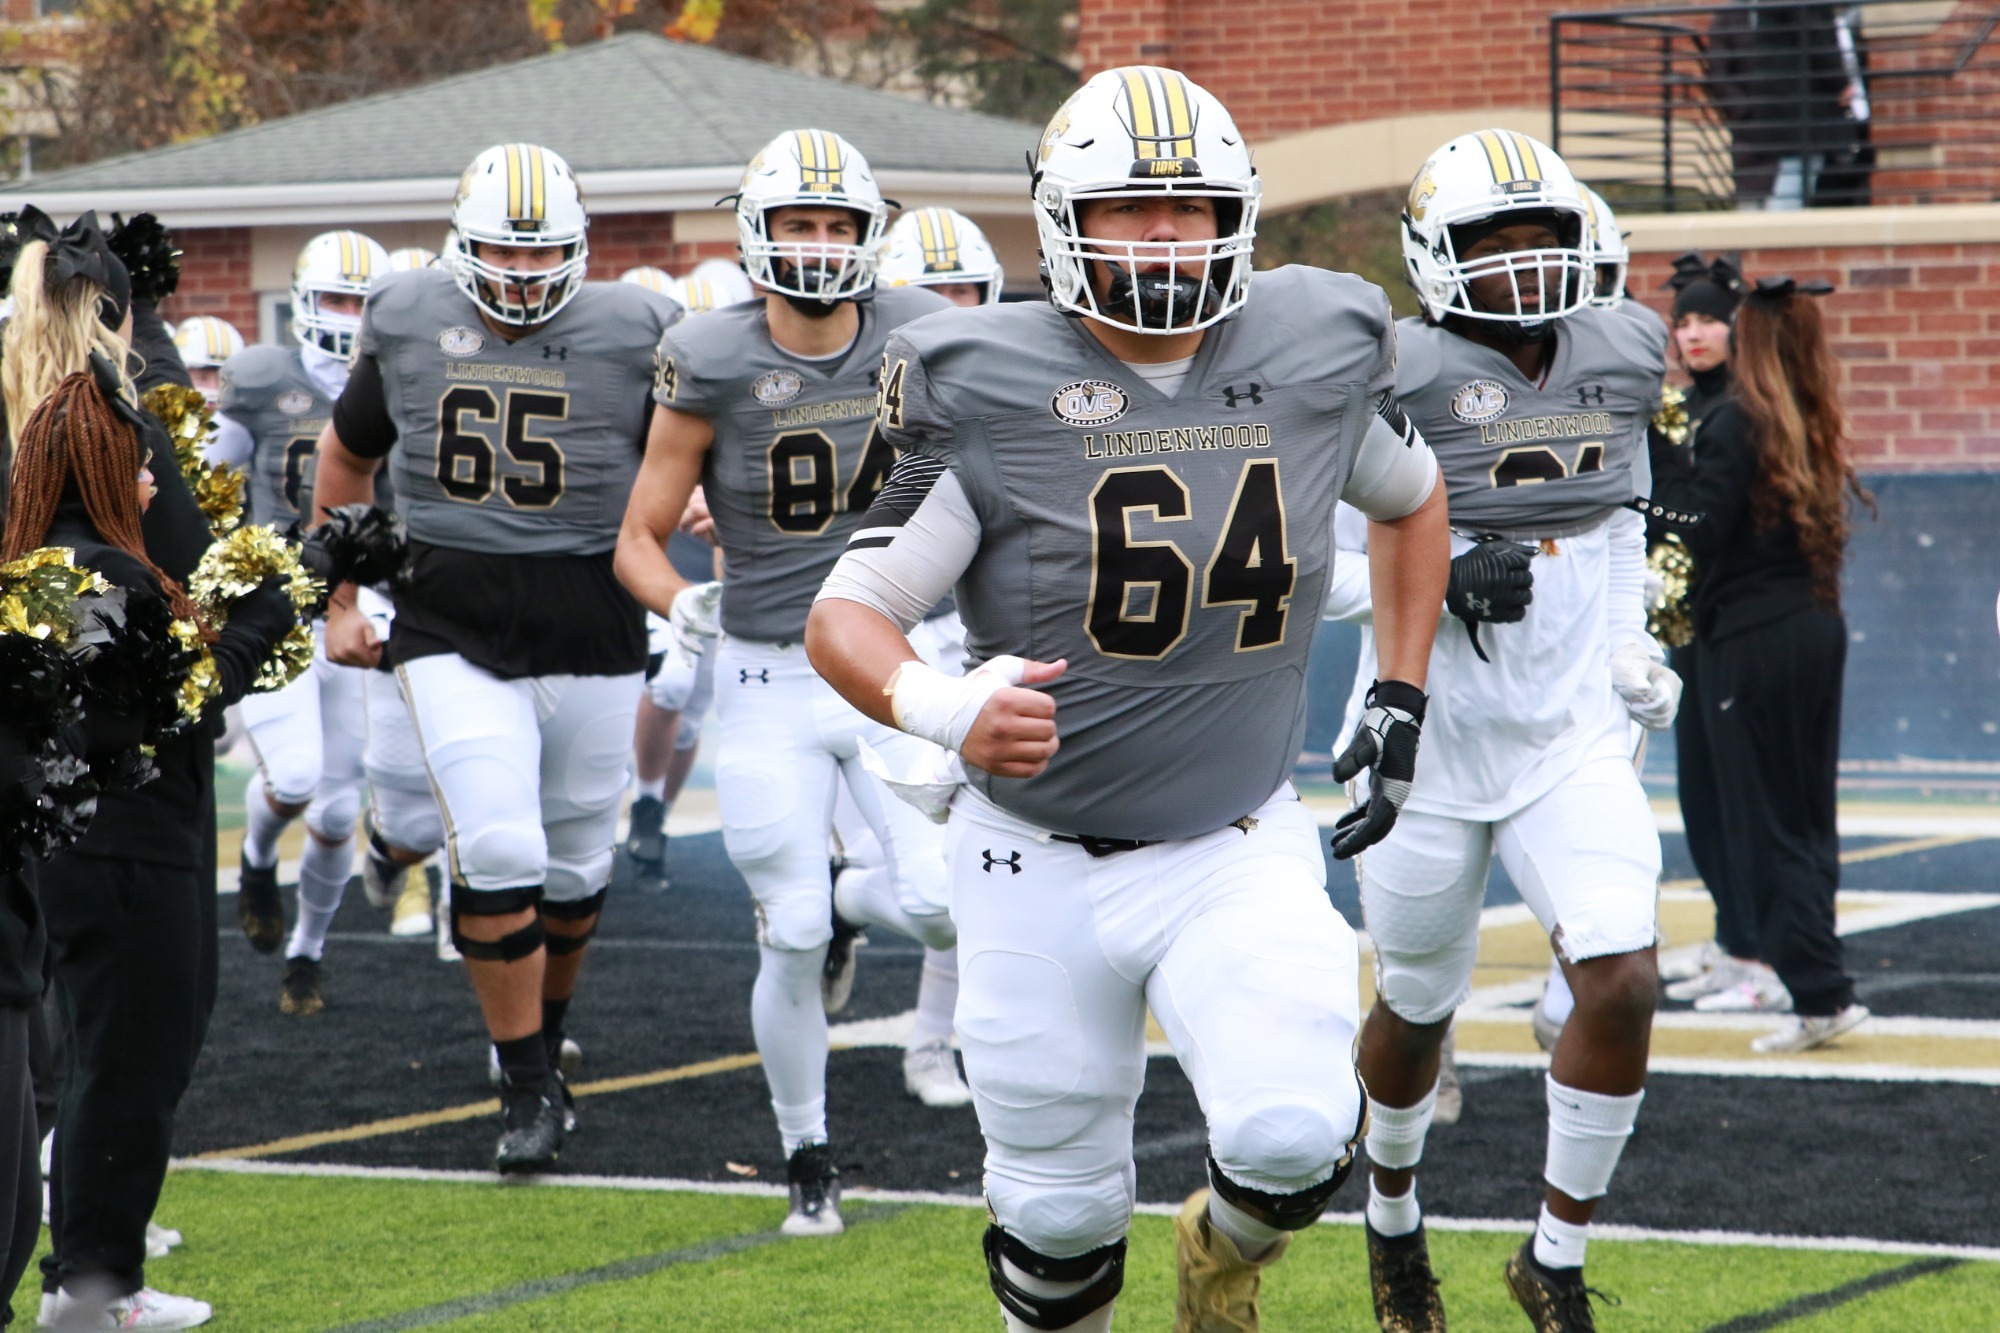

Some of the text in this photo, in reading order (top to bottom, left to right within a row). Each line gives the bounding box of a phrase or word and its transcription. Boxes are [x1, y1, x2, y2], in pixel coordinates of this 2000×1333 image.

[1150, 161, 1183, 175] LIONS
[1513, 181, 1533, 191] LIONS
[1154, 283, 1183, 291] Ridell
[446, 363, 565, 387] LINDENWOOD
[773, 395, 878, 428] LINDENWO
[1066, 391, 1115, 416] OVC
[1462, 391, 1499, 415] OVC
[1083, 423, 1272, 459] LINDENWOOD
[1480, 412, 1614, 445] LINDENWOOD
[434, 384, 570, 510] 65
[1083, 457, 1298, 662] 64
